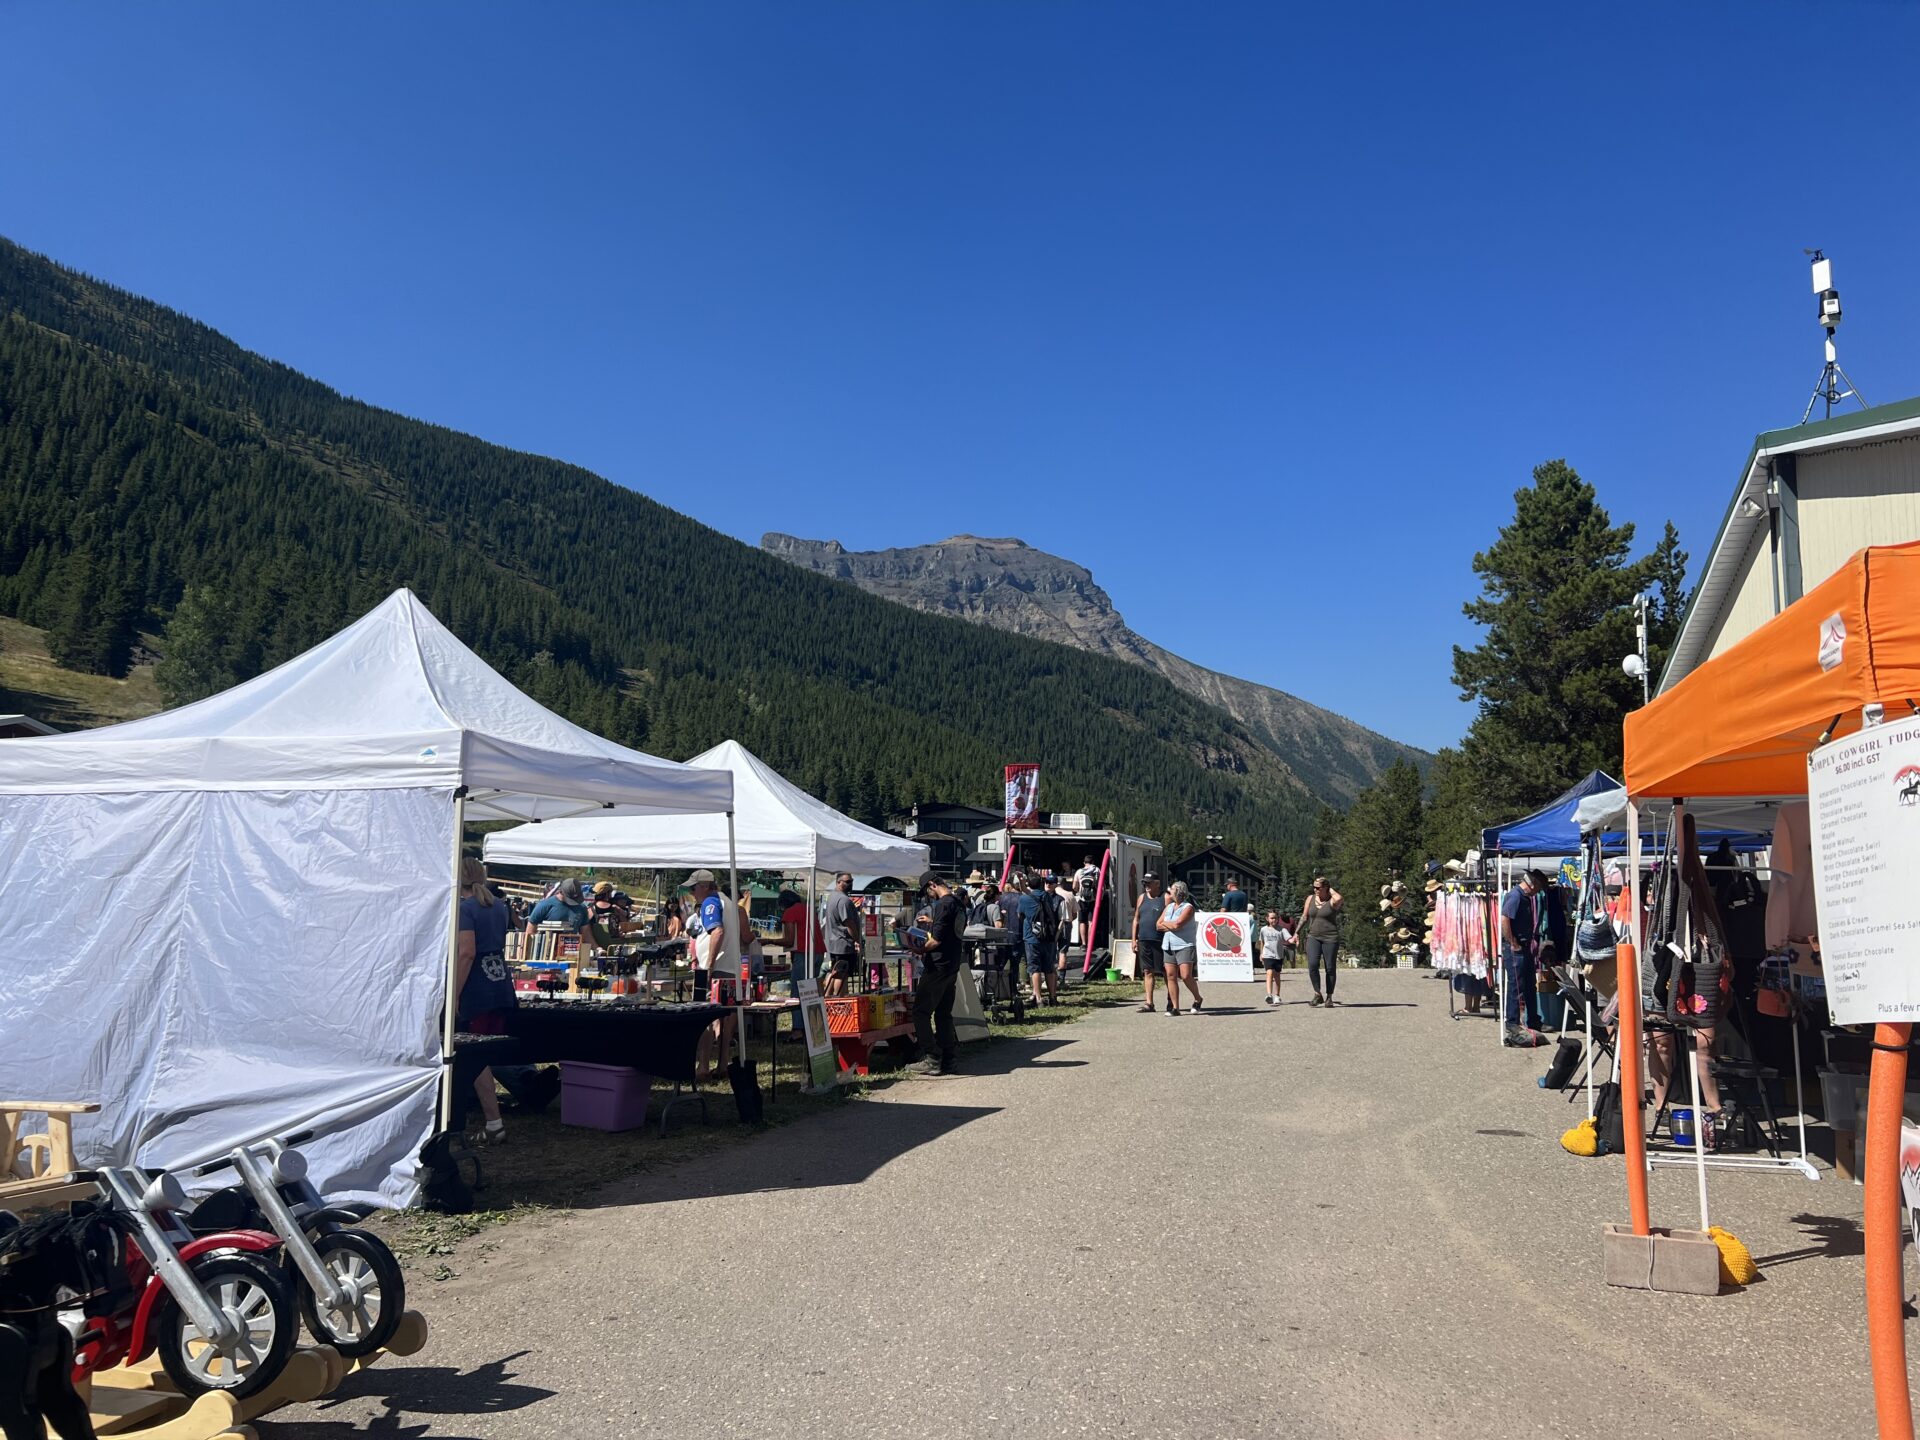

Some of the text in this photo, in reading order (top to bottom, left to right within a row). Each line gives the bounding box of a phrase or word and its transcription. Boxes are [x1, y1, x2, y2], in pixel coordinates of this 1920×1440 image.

[1811, 754, 1836, 773] SIMPLY
[1839, 740, 1883, 760] COWGIRL
[1835, 753, 1880, 774] $6.00 incl. GST
[1841, 778, 1867, 791] Chocolate
[1869, 772, 1885, 783] Swirl
[1844, 801, 1863, 812] Walnut
[1840, 811, 1867, 823] Chocolate
[1838, 845, 1864, 857] Chocolate
[1865, 841, 1881, 851] Swirl
[1835, 857, 1860, 869] Chocolate
[1862, 853, 1877, 863] Swirl
[1842, 866, 1869, 878] Chocolate
[1870, 863, 1886, 872] Swirl
[1842, 879, 1864, 889] Caramel
[1842, 896, 1857, 904] Pecan
[1852, 916, 1869, 925] Cream
[1841, 927, 1865, 938] Chocolate
[1866, 923, 1892, 934] Caramel
[1893, 922, 1905, 930] Sea
[1864, 947, 1894, 957] Chocolate
[1847, 961, 1867, 970] Caramel
[1878, 1003, 1893, 1013] Plus
[1893, 1004, 1899, 1012] a
[1900, 1002, 1915, 1012] few
